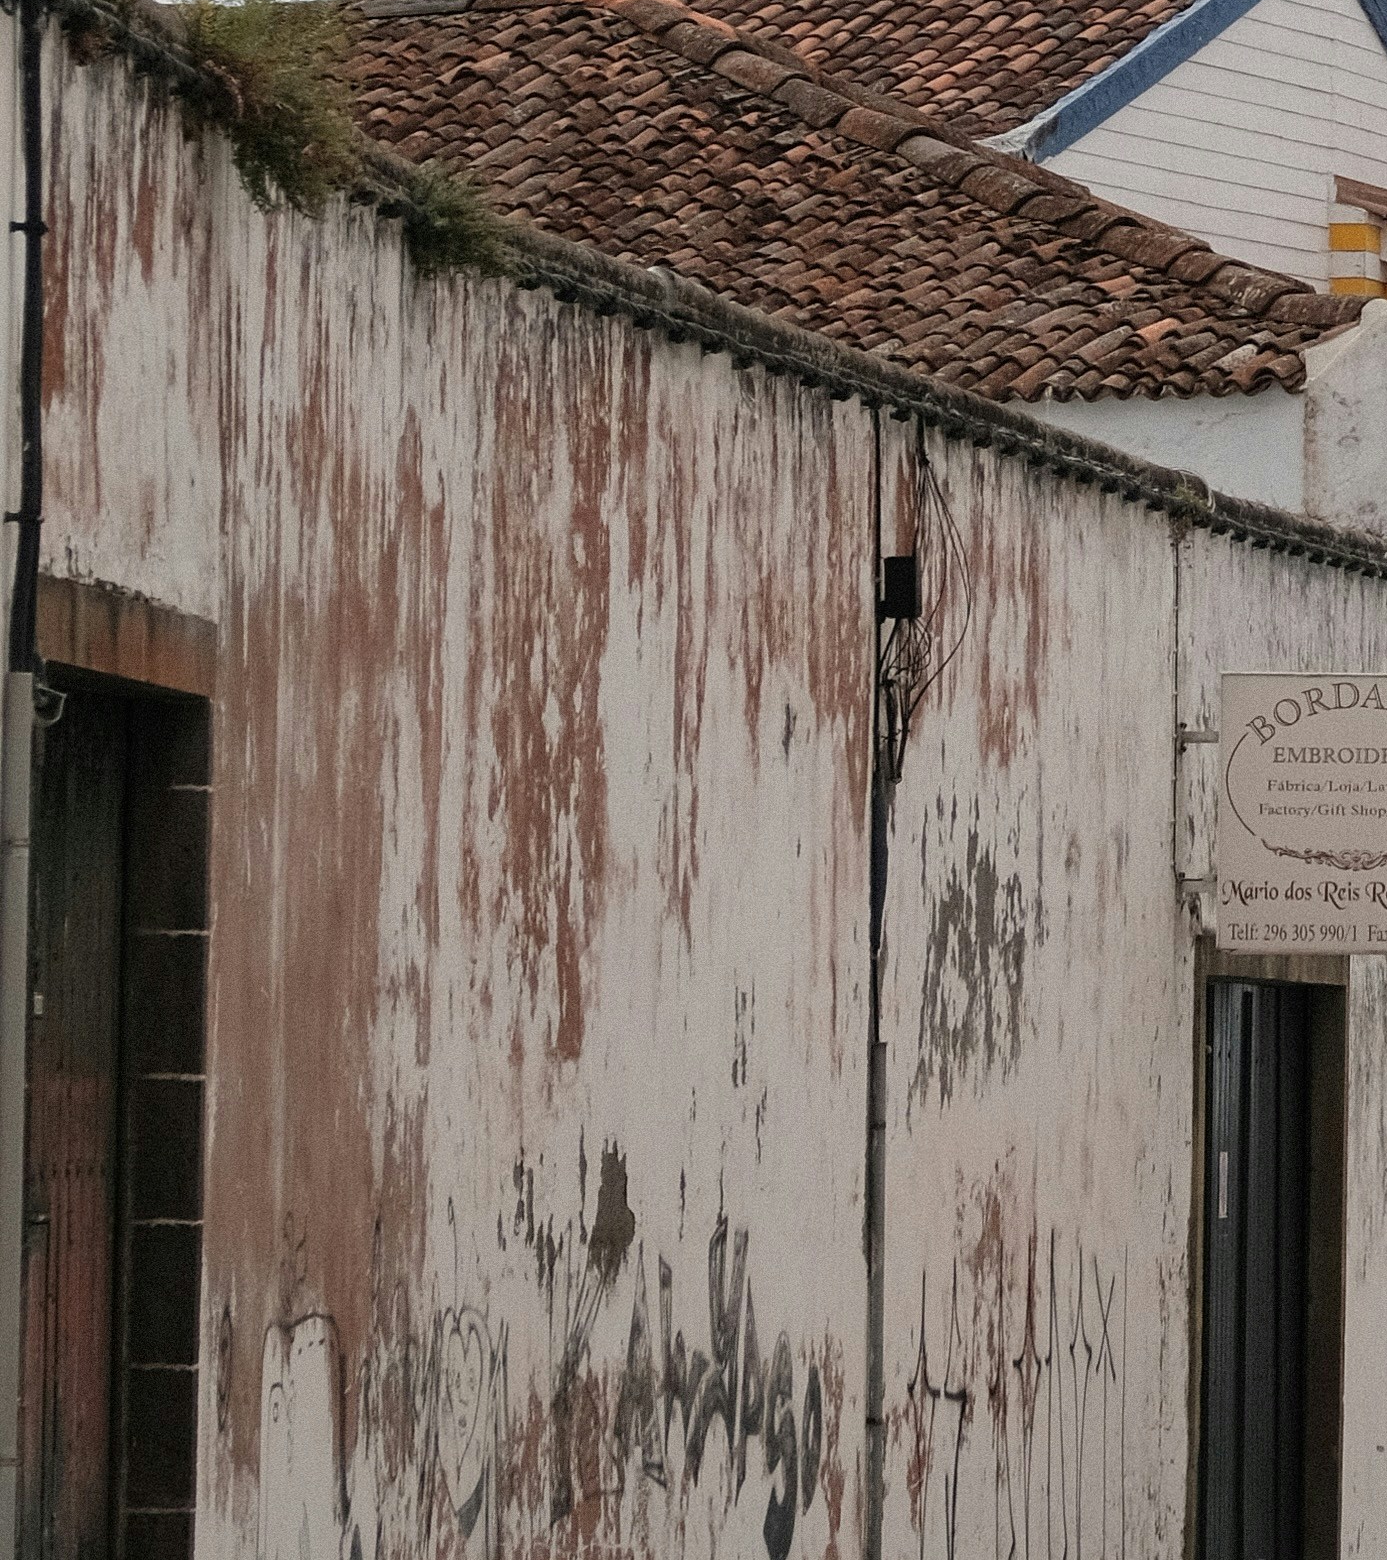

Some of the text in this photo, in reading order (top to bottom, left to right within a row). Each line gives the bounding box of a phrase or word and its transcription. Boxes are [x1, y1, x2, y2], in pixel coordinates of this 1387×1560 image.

[1258, 802, 1346, 818] Factory/Gift
[1284, 880, 1313, 901] dos
[1317, 881, 1360, 910] Reis
[1263, 923, 1288, 941] 296
[1291, 923, 1316, 942] 305
[1319, 924, 1358, 942] 990/1
